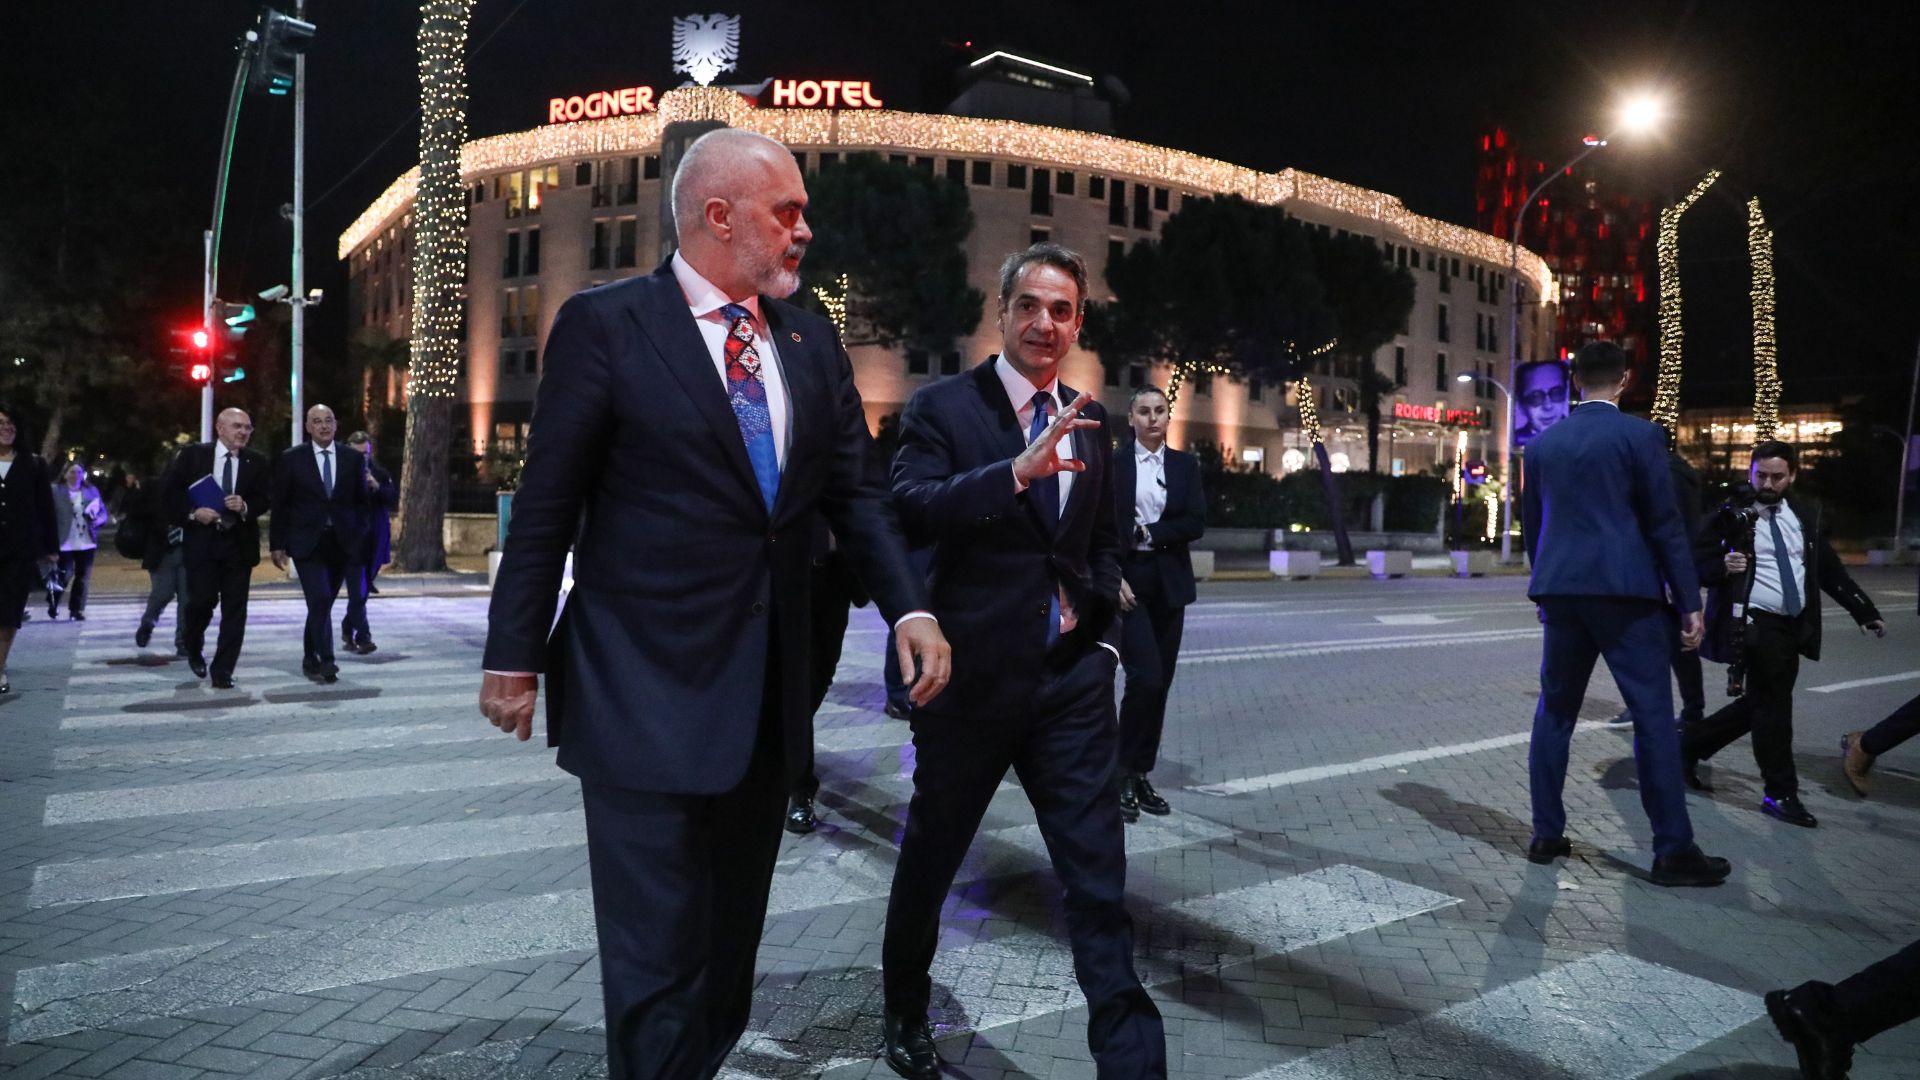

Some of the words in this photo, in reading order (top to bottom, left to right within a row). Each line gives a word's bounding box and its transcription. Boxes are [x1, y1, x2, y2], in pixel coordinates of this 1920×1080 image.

[549, 85, 655, 124] ROGNER
[773, 79, 883, 108] HOTEL
[1395, 402, 1442, 421] ROGNER
